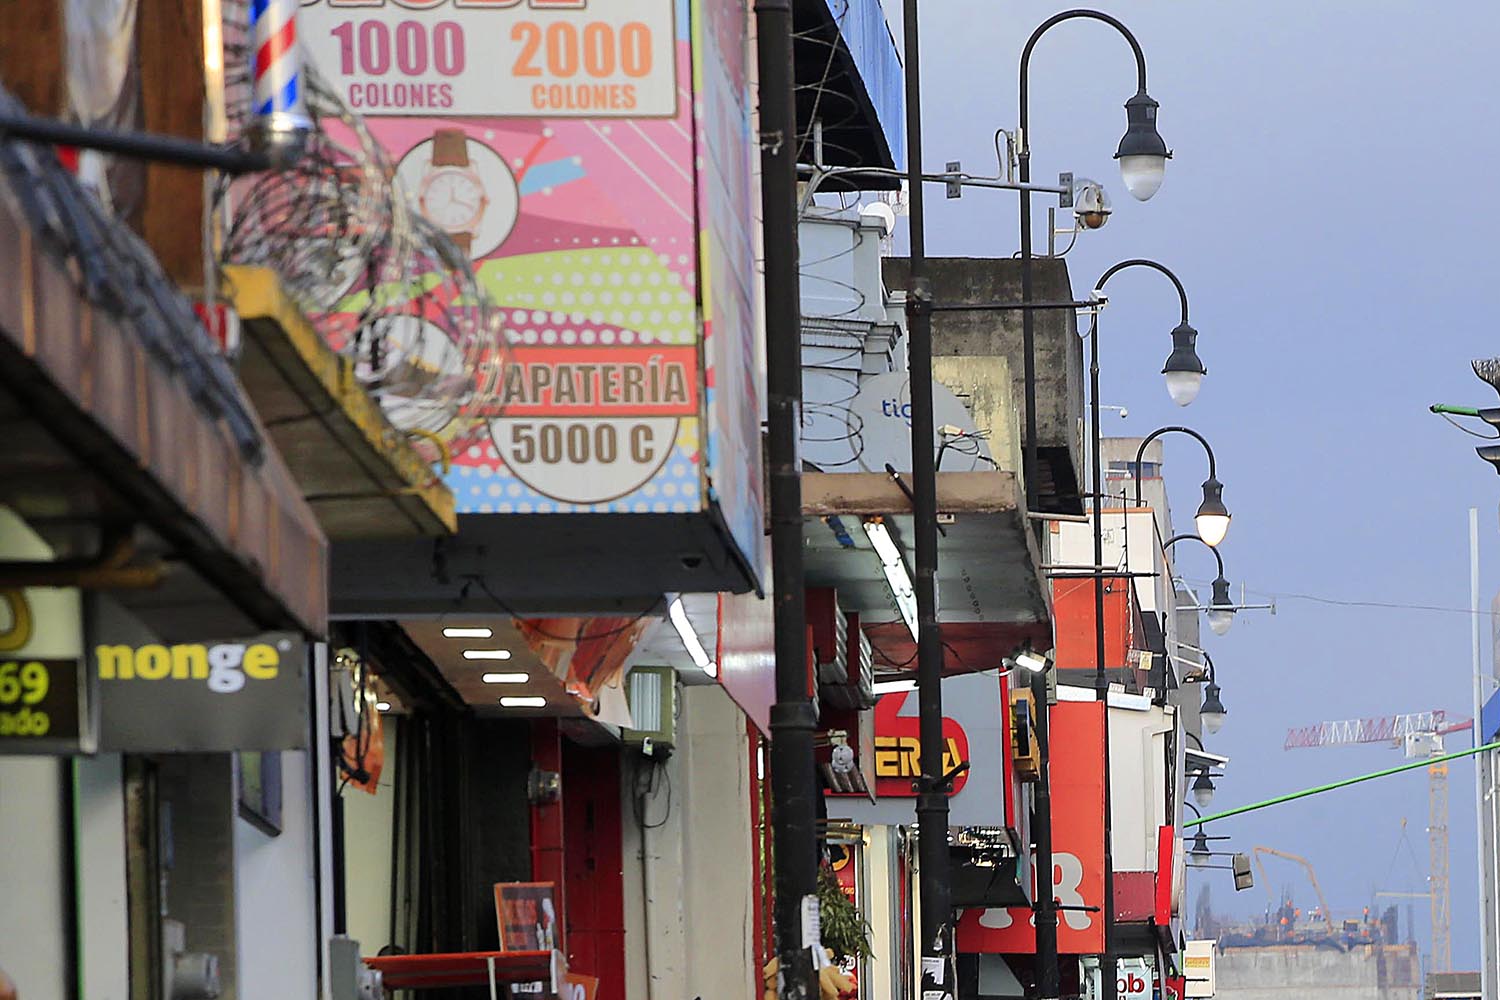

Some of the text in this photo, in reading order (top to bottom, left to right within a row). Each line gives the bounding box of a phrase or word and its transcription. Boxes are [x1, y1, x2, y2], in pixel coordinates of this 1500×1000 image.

[331, 20, 466, 77] 1000
[510, 21, 654, 79] 2000
[349, 82, 454, 108] COLONES
[531, 83, 637, 109] COLONES
[512, 424, 654, 465] 5000 C
[875, 736, 965, 778] ERA
